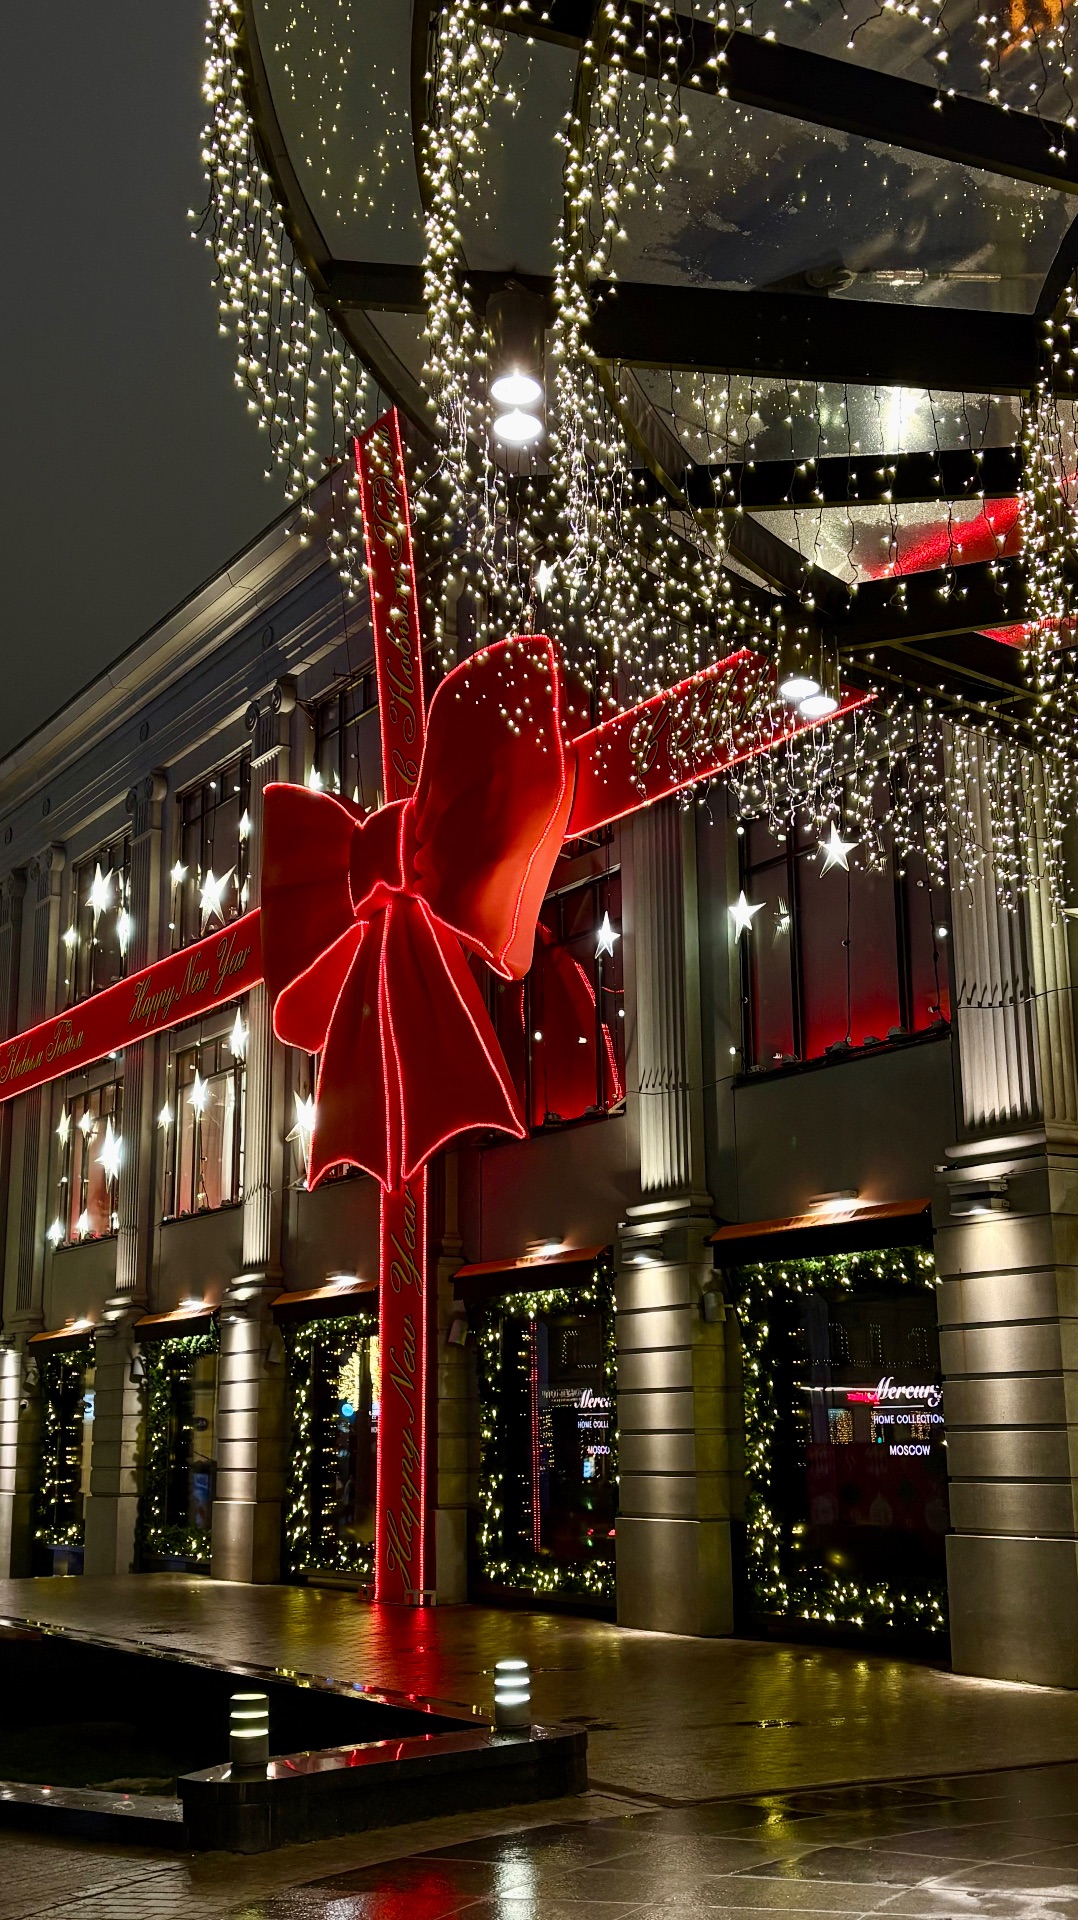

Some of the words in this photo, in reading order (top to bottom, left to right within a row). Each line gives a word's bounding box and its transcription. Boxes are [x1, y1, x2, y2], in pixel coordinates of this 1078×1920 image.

[128, 975, 176, 1028] Happy
[174, 950, 211, 1002] New
[213, 932, 252, 995] Year
[390, 1184, 423, 1297] Year
[390, 1315, 416, 1424] New
[867, 1376, 943, 1408] Mercury
[577, 1420, 593, 1429] HOME
[873, 1415, 895, 1425] HOME
[896, 1414, 945, 1425] COLLECTION
[587, 1445, 611, 1455] MOSCO
[889, 1444, 931, 1456] MOSCOW
[386, 1427, 421, 1591] Happy
